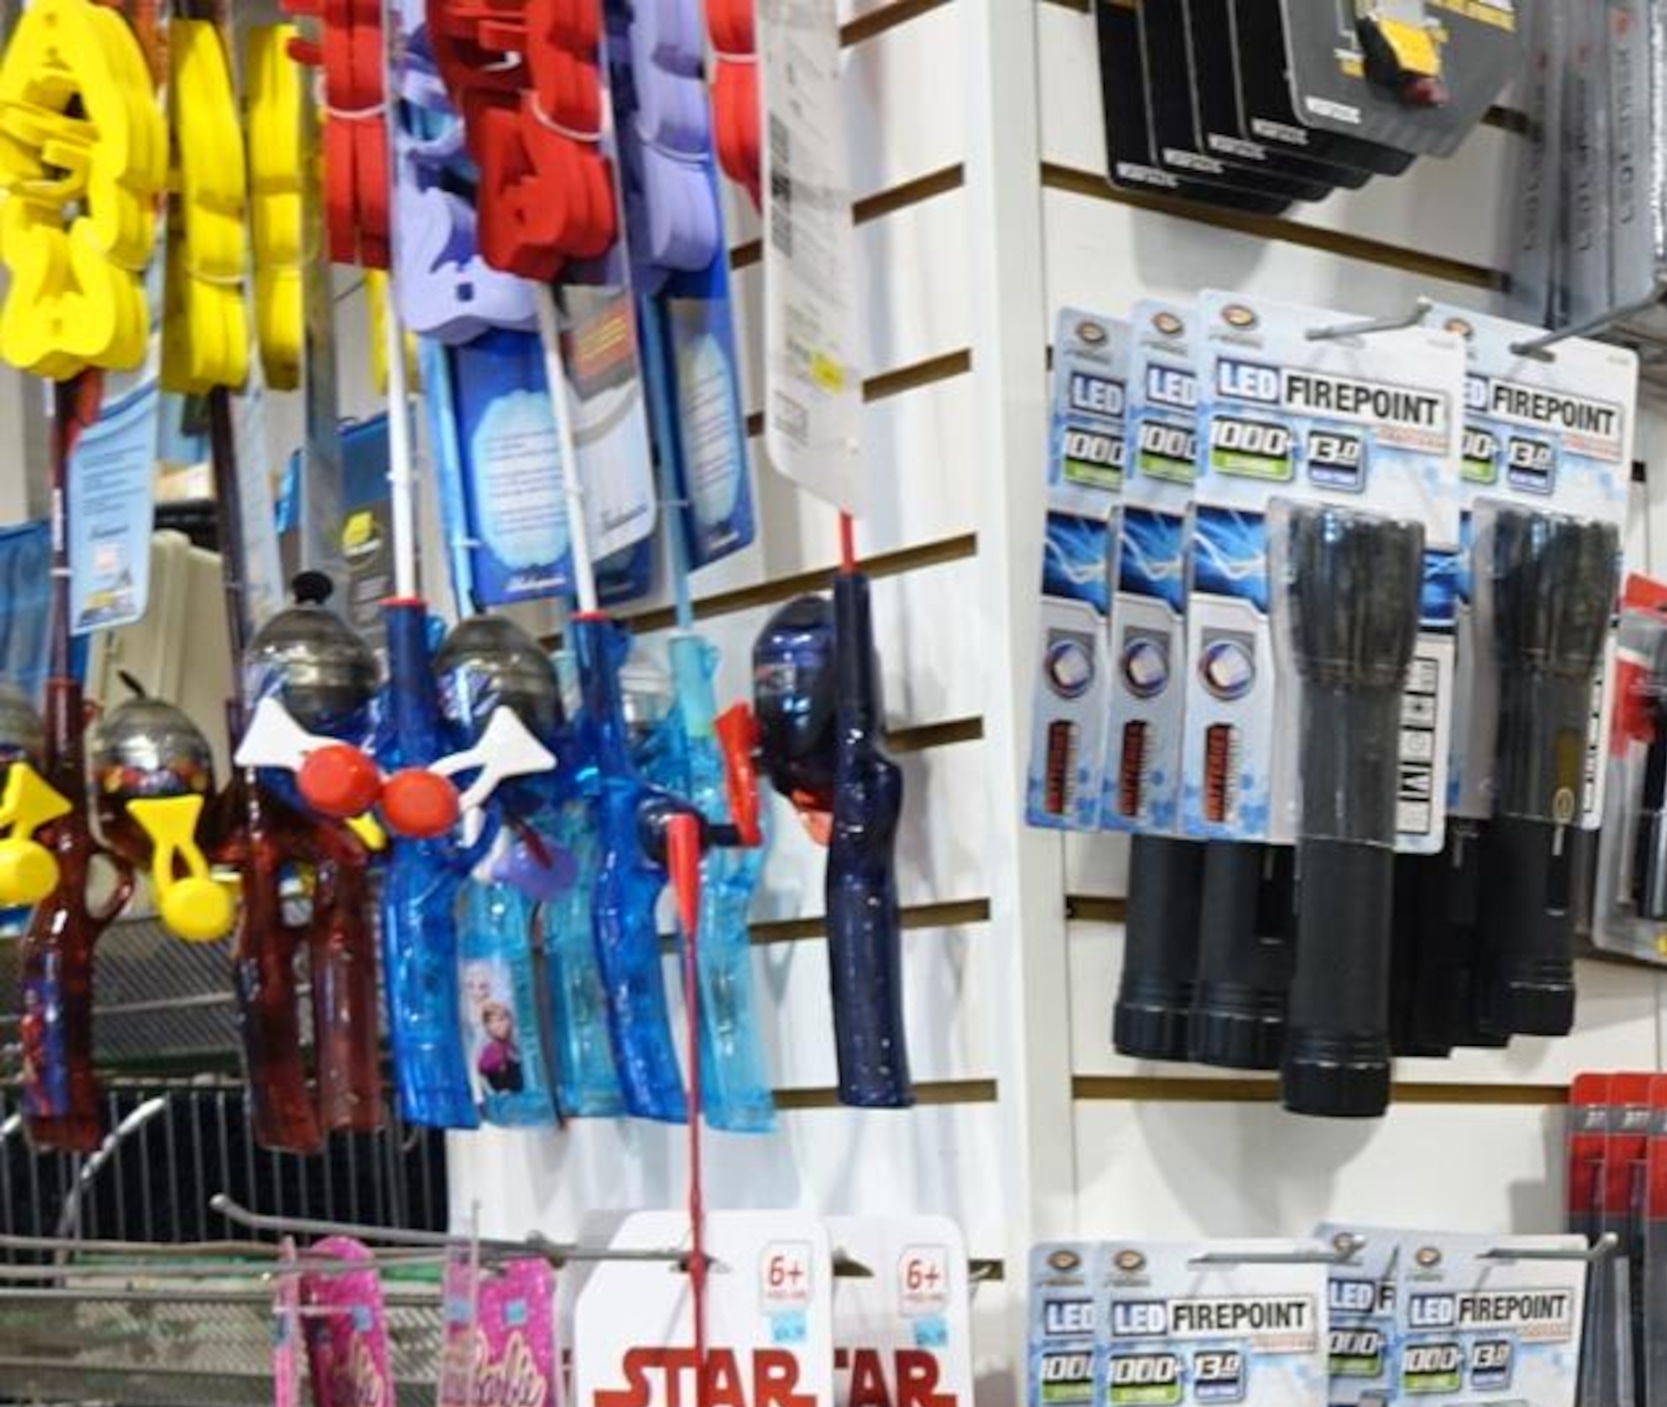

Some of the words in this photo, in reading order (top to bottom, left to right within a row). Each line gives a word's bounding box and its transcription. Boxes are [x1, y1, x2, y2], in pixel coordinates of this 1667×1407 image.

[1072, 376, 1124, 418] LED
[1219, 358, 1279, 400] LED
[1286, 375, 1440, 426] FIREPOINT
[1492, 385, 1616, 437] FIREPOINT
[769, 1256, 803, 1288] 6+
[907, 1258, 940, 1291] 6+
[1331, 1280, 1374, 1310] LED
[1411, 1296, 1453, 1327] LED
[1459, 1294, 1567, 1325] FIREPOINT
[1113, 1302, 1166, 1335] LED
[1172, 1301, 1308, 1332] FIREPOINT
